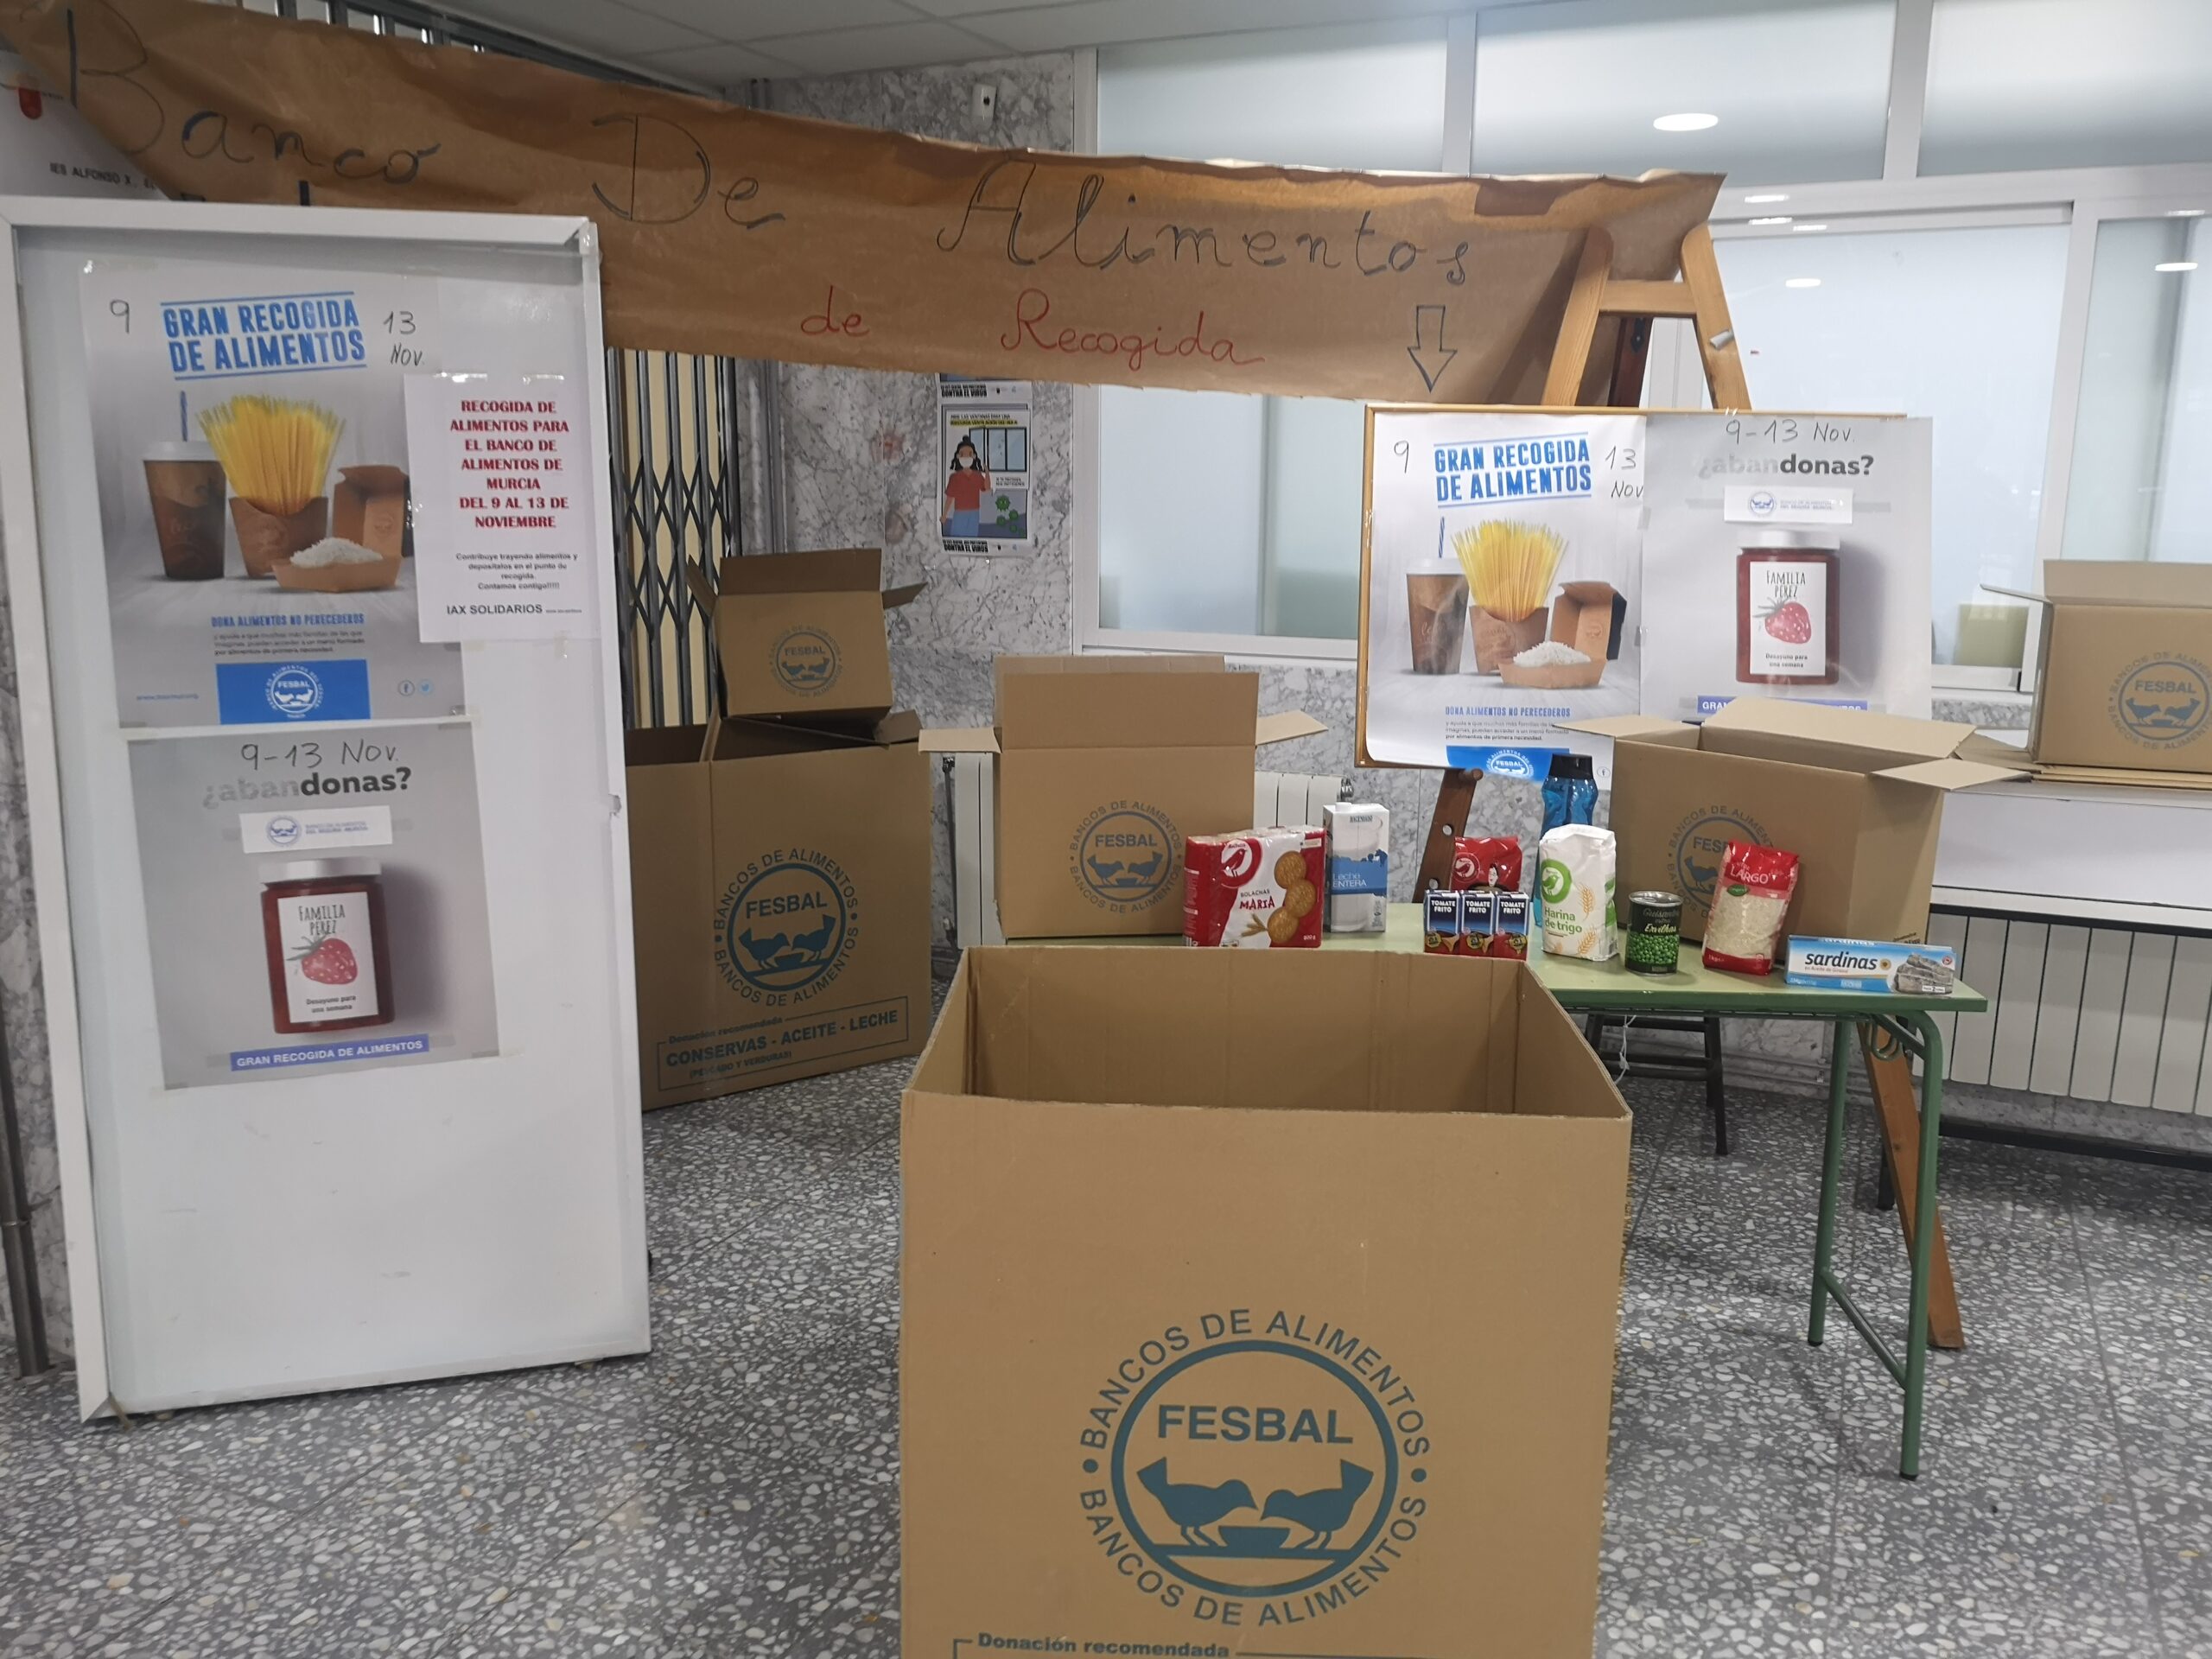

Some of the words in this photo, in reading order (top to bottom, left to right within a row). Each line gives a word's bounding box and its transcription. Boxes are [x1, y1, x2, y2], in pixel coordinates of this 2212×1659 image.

[60, 0, 441, 183] Banco
[592, 113, 785, 230] De
[937, 159, 1469, 286] Alimentos
[72, 167, 121, 185] ALFONSO
[109, 299, 130, 334] 9
[162, 306, 231, 339] GRAN
[238, 299, 360, 334] RECOGIDA
[383, 311, 416, 335] 13
[800, 284, 870, 338] de
[1001, 289, 1266, 371] Recogida
[168, 340, 206, 373] DE
[215, 328, 366, 371] ALIMENTOS
[461, 400, 533, 413] RECOGIDA
[537, 401, 556, 413] DE
[450, 420, 528, 432] ALIMENTOS
[532, 420, 569, 432] PARA
[465, 439, 482, 451] EL
[486, 439, 534, 451] BANCO
[538, 439, 557, 451] DE
[1434, 446, 1484, 473] GRAN
[1493, 438, 1590, 469] RECOGIDA
[461, 459, 539, 471] ALIMENTOS
[543, 458, 563, 471] DE
[1393, 439, 1409, 474] 9
[1605, 445, 1637, 470] 13
[486, 478, 541, 490] MURCIA
[1436, 474, 1462, 501] DE
[1470, 464, 1592, 500] ALIMENTOS
[460, 497, 487, 509] DEL
[491, 497, 501, 508] 9
[505, 497, 523, 509] AL
[529, 497, 545, 508] 13
[550, 497, 569, 509] DE
[474, 516, 556, 528] NOVIEMBRE
[1766, 570, 1806, 585] FAMILIA
[238, 614, 287, 627] ALIMENTOS
[289, 614, 302, 626] NO
[304, 613, 365, 626] PERECEDEROS
[447, 605, 467, 615] IAX
[469, 604, 543, 615] SOLIDARIOS
[2134, 680, 2197, 694] FESBAL
[1445, 706, 1465, 715] DONA
[1465, 707, 1506, 716] ALIMENTOS
[1509, 708, 1518, 716] NO
[1521, 708, 1571, 718] PERECEDEROS
[202, 766, 412, 810] ¿abandonas?
[1711, 805, 1727, 815] DE
[1070, 805, 1107, 851] BANCOS
[1110, 800, 1128, 810] DE
[1132, 801, 1182, 849] ALIMENTOS
[1095, 833, 1158, 848] FESBAL
[1332, 880, 1367, 888] ENTERA
[1730, 863, 1769, 885] LARGO
[713, 862, 759, 931] BANCOS
[761, 849, 784, 868] DE
[789, 848, 859, 911] ALIMENTOS
[1070, 865, 1106, 909] BANCOS
[1109, 904, 1126, 914] DE
[1131, 865, 1182, 913] ALIMENTOS
[1240, 888, 1270, 898] BOLACHAS
[298, 904, 346, 922] FAMILIA
[746, 891, 828, 919] FESBAL
[1239, 895, 1275, 910] MARIA
[1544, 906, 1576, 921] Harina
[1545, 918, 1555, 929] de
[1557, 920, 1583, 935] trigo
[715, 949, 762, 1004] BANCOS
[766, 994, 787, 1007] DE
[792, 926, 859, 1004] ALIMENTOS
[1804, 951, 1878, 970] sardinas
[666, 1036, 767, 1067] CONSERVAS
[781, 1021, 837, 1045] ACEITE
[849, 1009, 898, 1032] LECHE
[236, 1054, 270, 1067] GRAN
[273, 1049, 336, 1064] RECOGIDA
[338, 1046, 354, 1057] DE
[356, 1039, 423, 1055] ALIMENTOS
[1080, 1325, 1190, 1449] BANCOS
[1200, 1308, 1252, 1339] DE
[1266, 1310, 1431, 1457] ALIMENTOS
[1158, 1404, 1354, 1444] FESBAL
[1080, 1488, 1185, 1608] BANCOS
[1193, 1595, 1243, 1626] DE
[1258, 1495, 1427, 1627] ALIMENTOS
[978, 1632, 1077, 1653] Donación
[1084, 1640, 1230, 1658] recomendada
